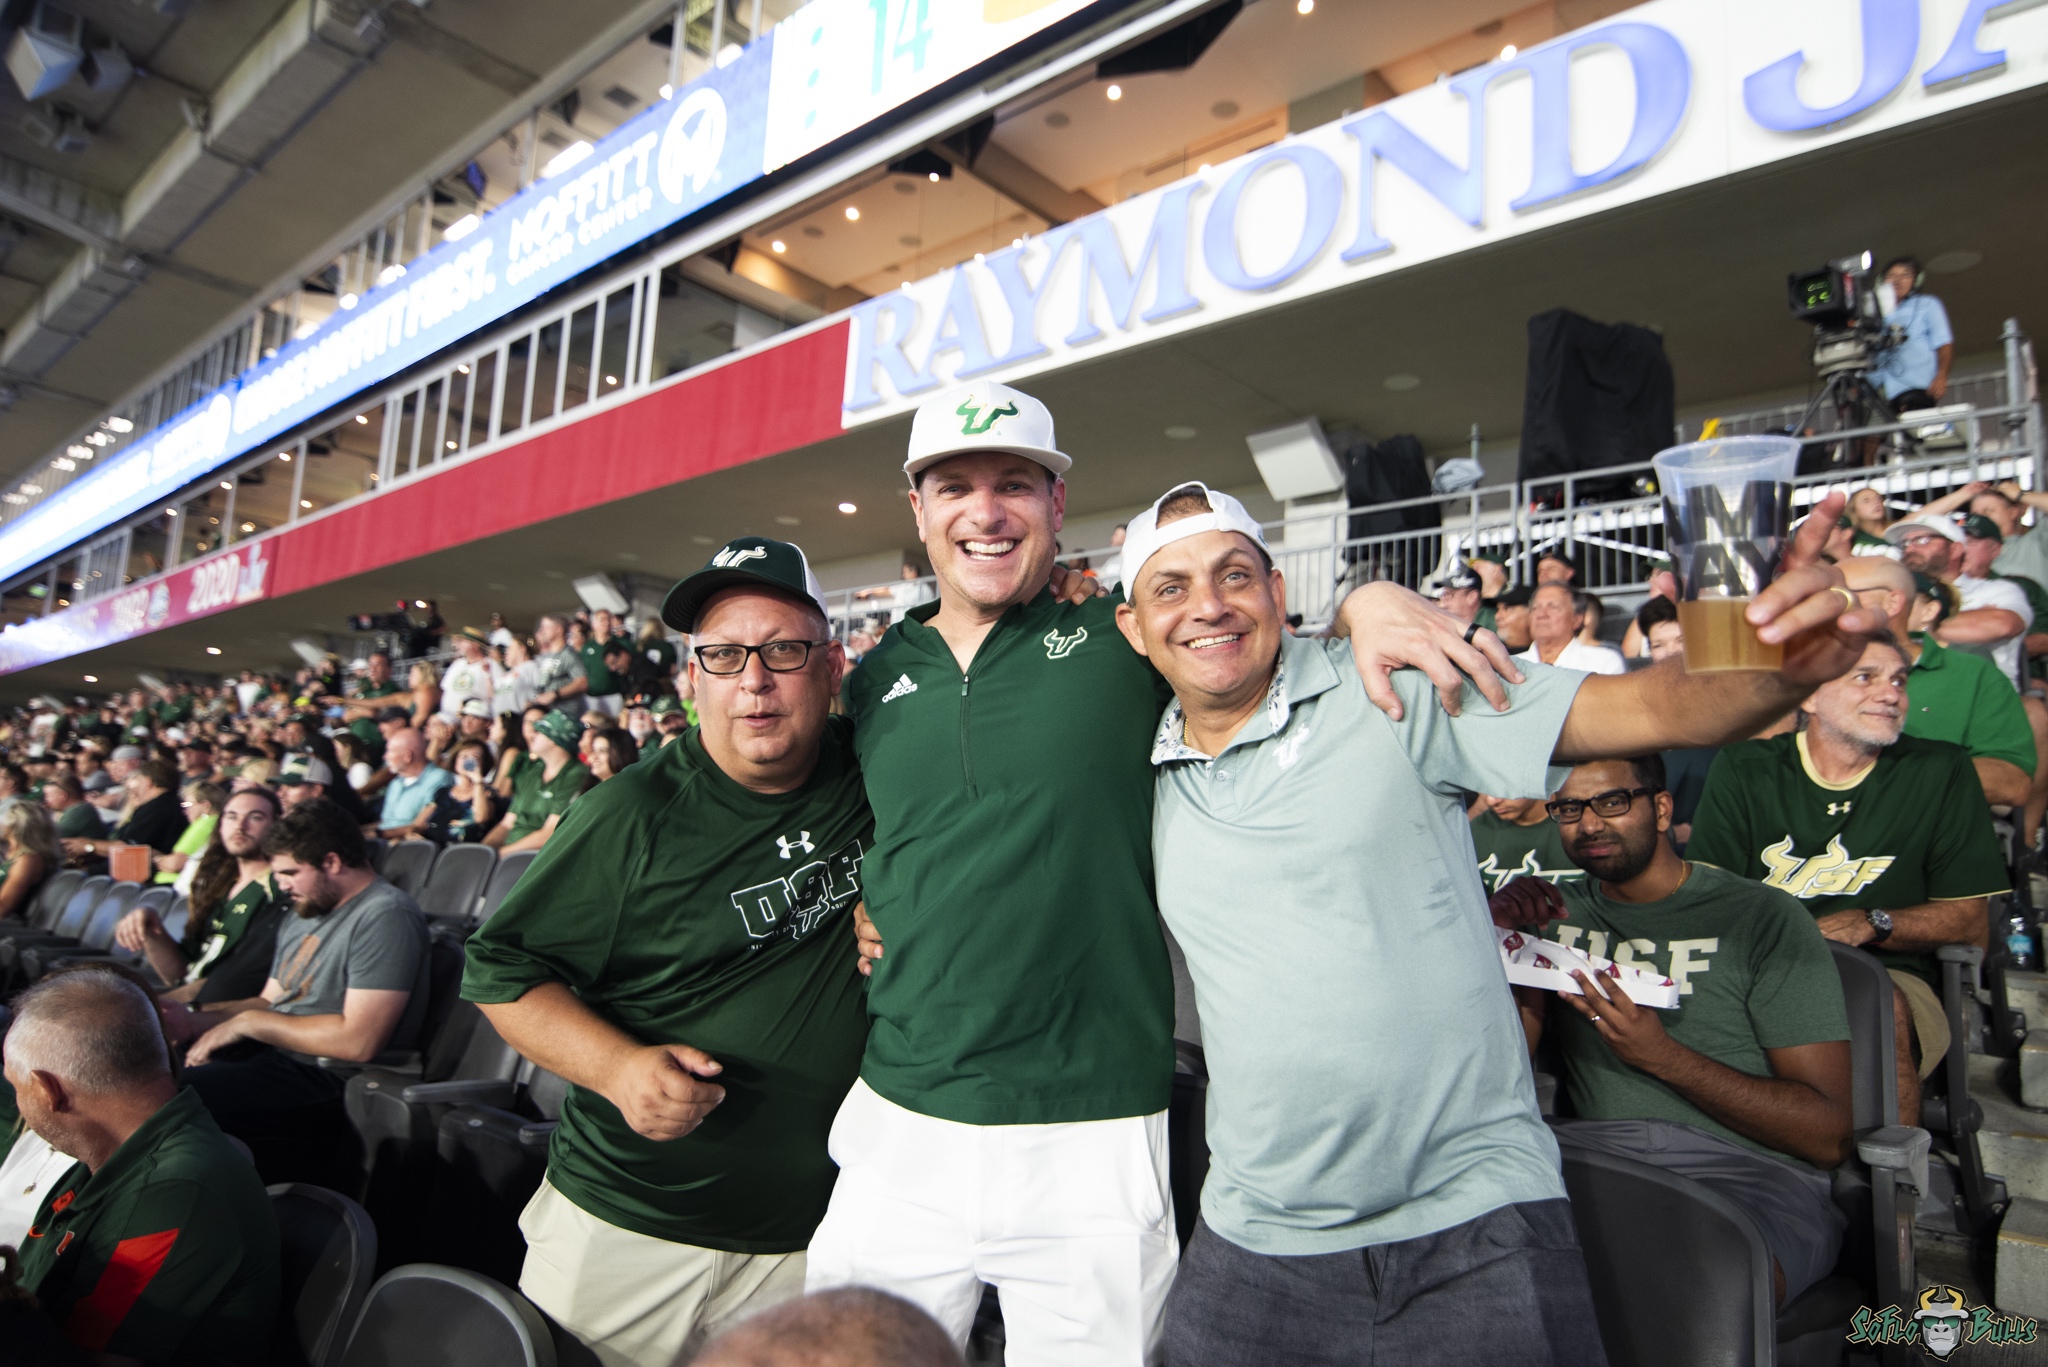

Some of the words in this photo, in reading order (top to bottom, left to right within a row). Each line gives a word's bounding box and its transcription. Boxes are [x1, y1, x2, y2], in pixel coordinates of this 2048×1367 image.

[506, 232, 574, 286] CANCER
[577, 186, 653, 246] CENTER
[508, 131, 658, 261] MOFFITT
[842, 21, 1692, 413] RAYMOND
[187, 554, 240, 614] 2020
[882, 682, 918, 703] adidas
[731, 839, 864, 938] USF
[1761, 833, 1897, 899] USF
